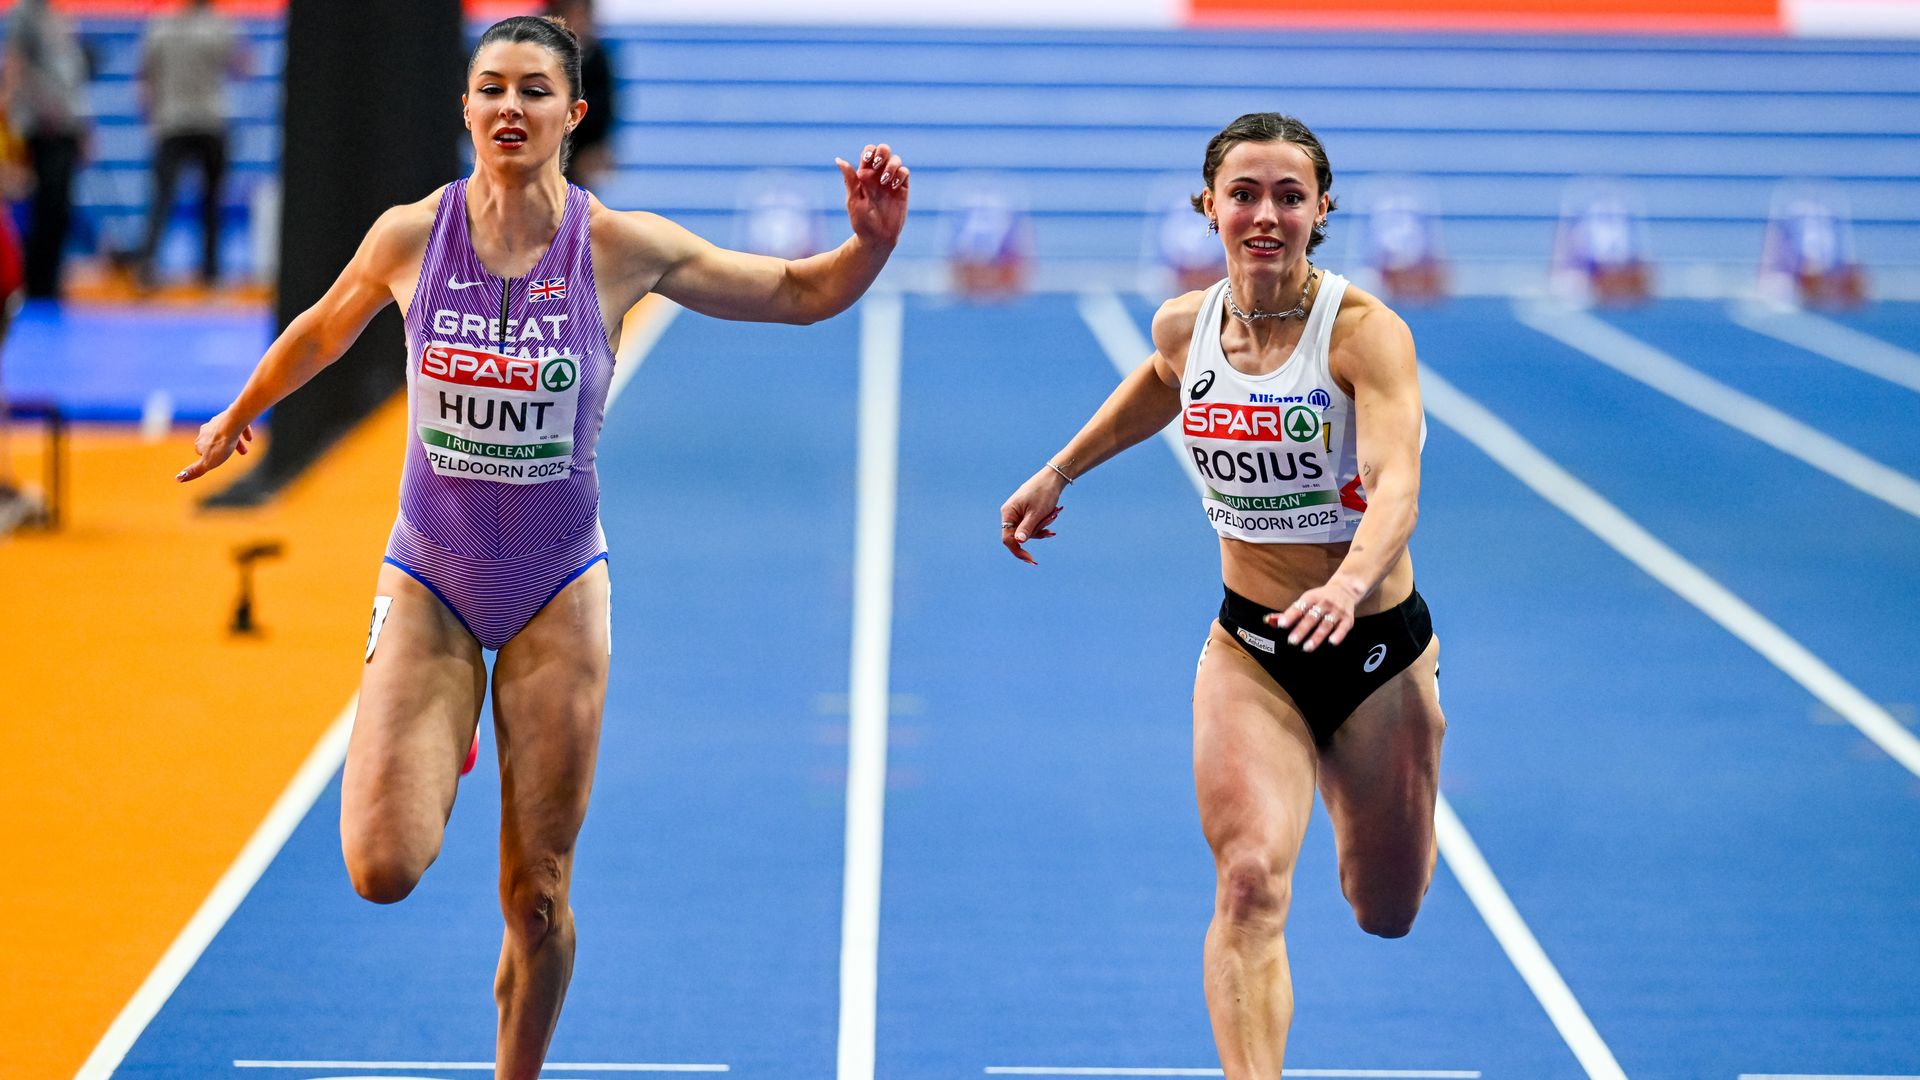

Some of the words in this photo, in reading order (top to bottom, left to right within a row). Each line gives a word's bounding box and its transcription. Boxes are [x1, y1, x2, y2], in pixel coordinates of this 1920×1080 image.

[433, 309, 568, 342] GREAT
[423, 348, 536, 387] SPAR
[439, 391, 554, 432] HUNT
[1185, 406, 1279, 437] SPAR
[446, 435, 450, 447] I
[452, 437, 482, 455] RUN
[427, 452, 523, 478] PELDOORN
[528, 461, 566, 478] 2025
[1192, 446, 1323, 484] ROSIUS
[1207, 507, 1294, 531] APELDOORN
[1297, 510, 1338, 529] 2025
[1225, 497, 1250, 510] RUN
